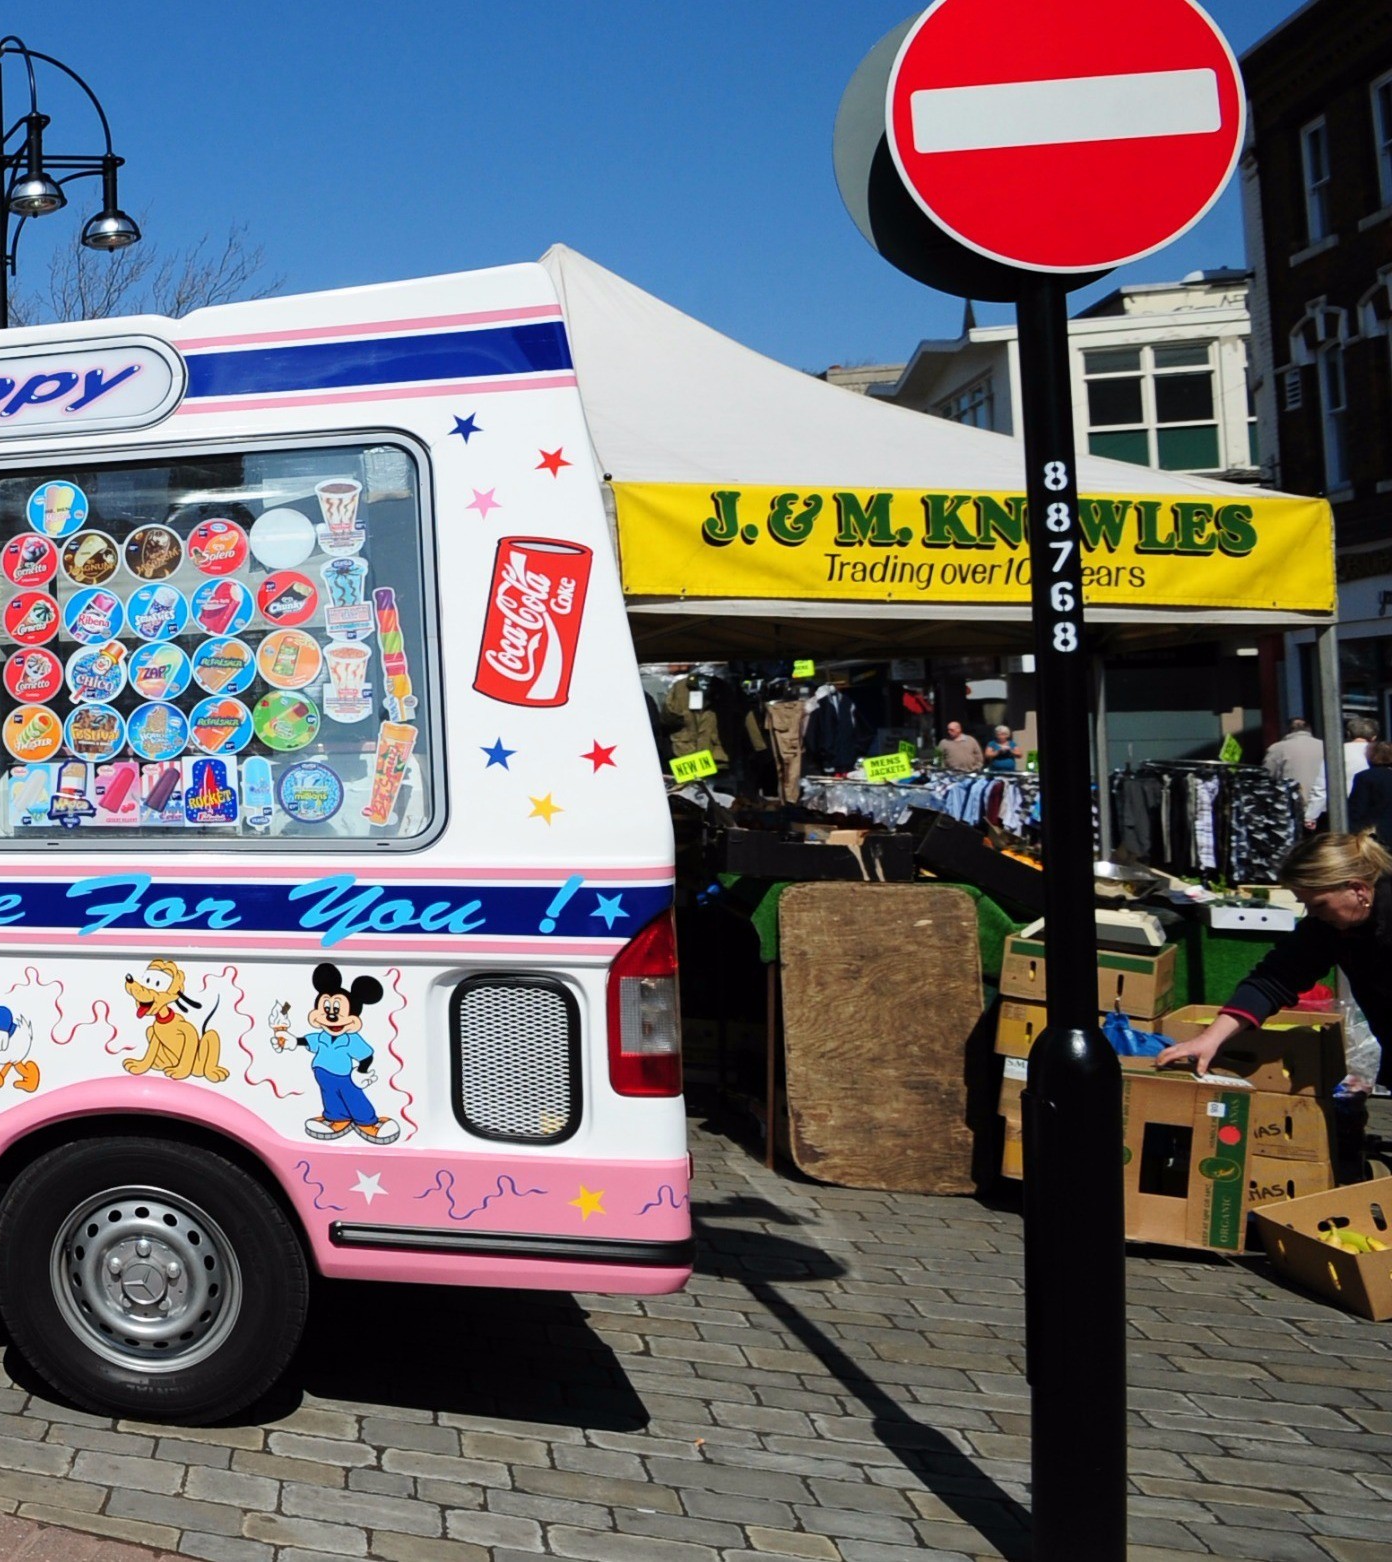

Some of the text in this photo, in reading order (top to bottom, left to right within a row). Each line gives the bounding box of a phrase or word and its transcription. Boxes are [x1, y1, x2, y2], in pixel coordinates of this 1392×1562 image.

[701, 489, 1258, 558] J. & M. KNWLES
[200, 549, 236, 563] Solero
[823, 552, 935, 591] Trading
[940, 559, 1003, 586] over
[1080, 558, 1146, 588] ears
[550, 576, 577, 615] Coke
[268, 599, 306, 615] Chunky
[17, 622, 47, 636] Cornetto
[78, 613, 111, 628] Ribena
[15, 679, 50, 692] Cornetto
[674, 756, 712, 777] NEW IN
[869, 764, 906, 778] JACKETS
[870, 756, 902, 768] MENS
[188, 789, 232, 809] ROCKET
[65, 873, 243, 937] For
[288, 873, 487, 948] You
[538, 874, 585, 935] !
[1219, 1195, 1233, 1243] ORGANIC
